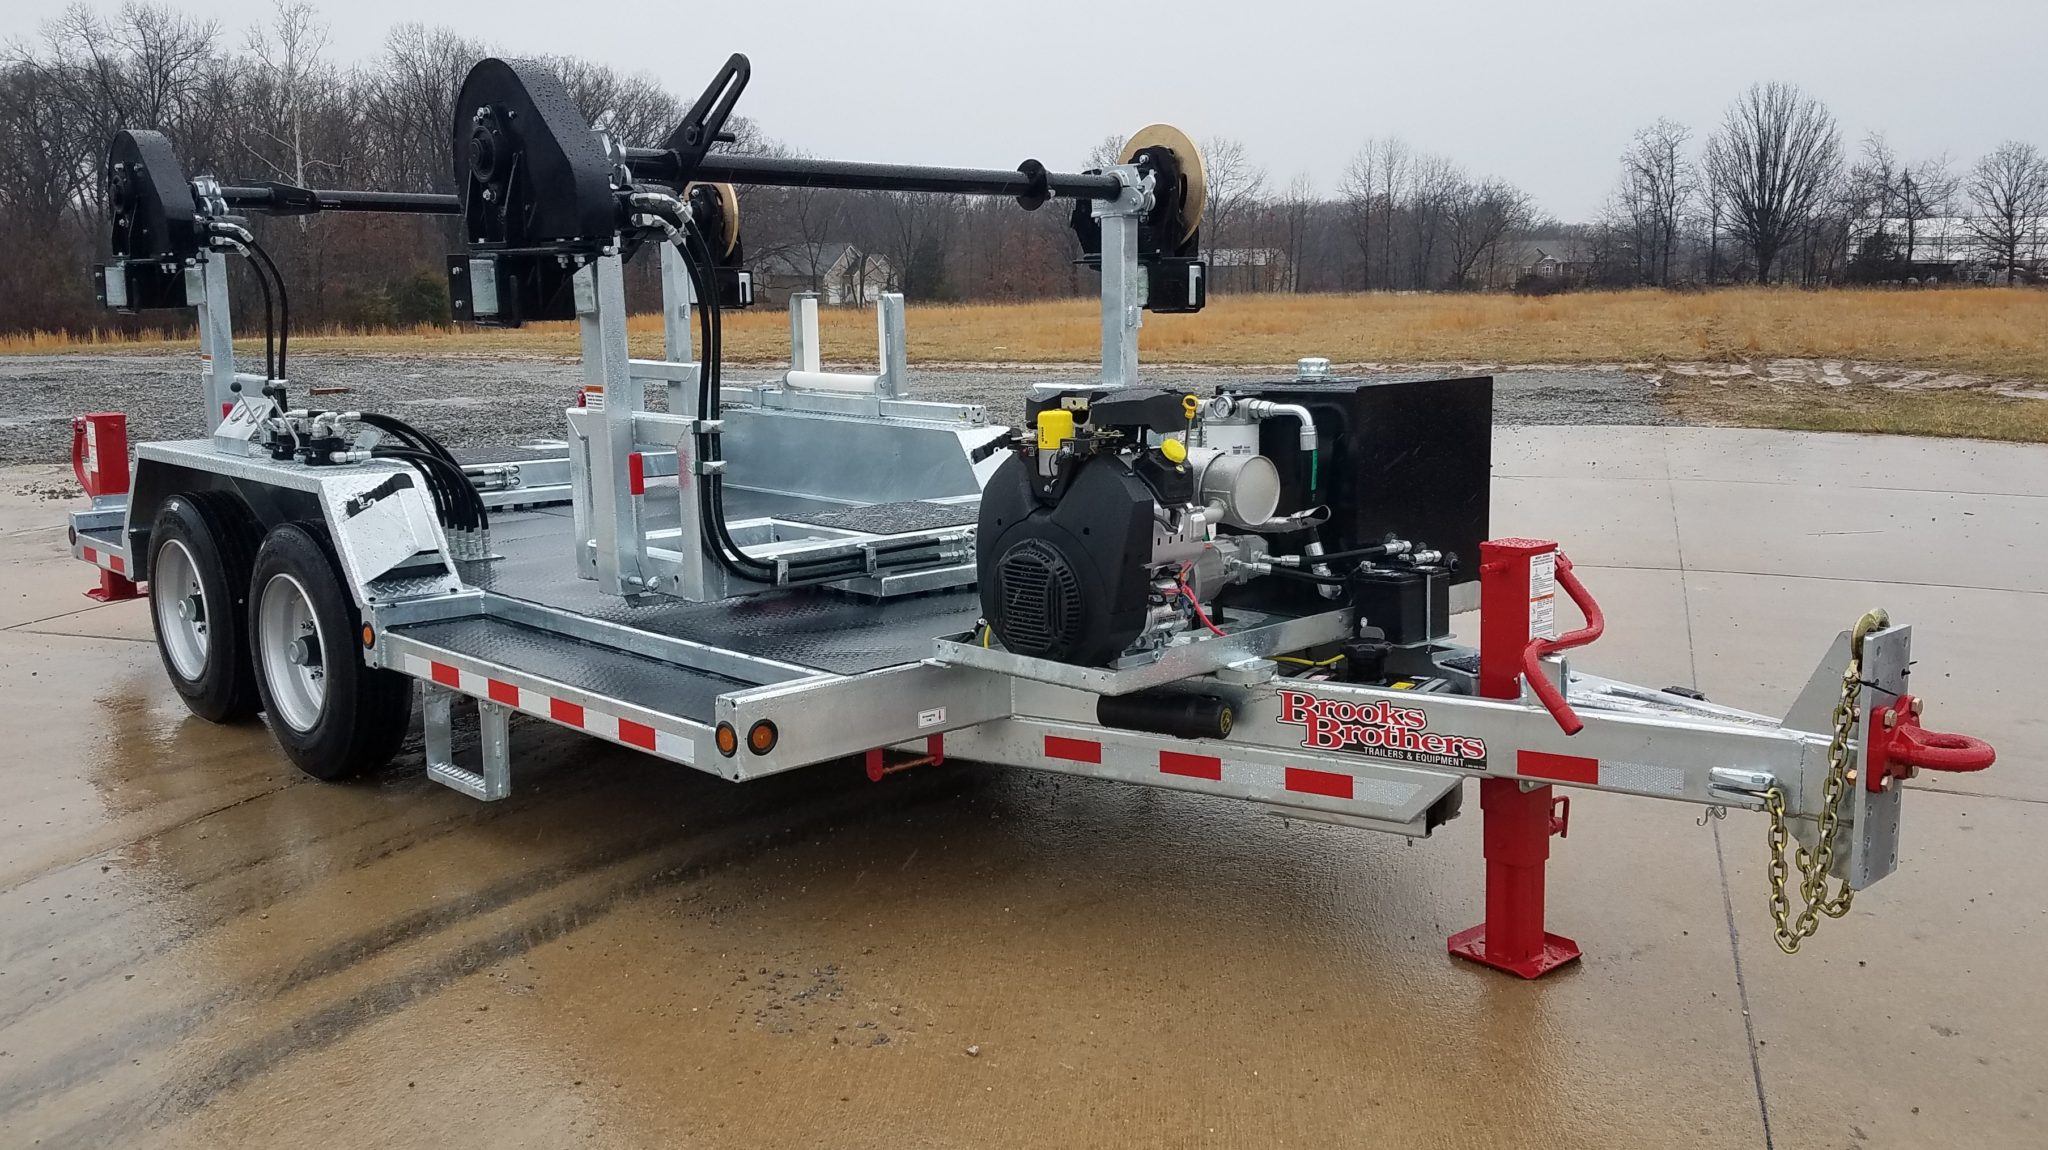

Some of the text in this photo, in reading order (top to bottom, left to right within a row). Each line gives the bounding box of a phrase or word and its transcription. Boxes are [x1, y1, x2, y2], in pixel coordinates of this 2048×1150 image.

[1277, 690, 1427, 731] Brooks
[1302, 715, 1486, 759] Brothers
[1364, 746, 1403, 759] TRAILERS
[1407, 752, 1413, 761] &
[1416, 754, 1465, 767] EQUIPMENT
